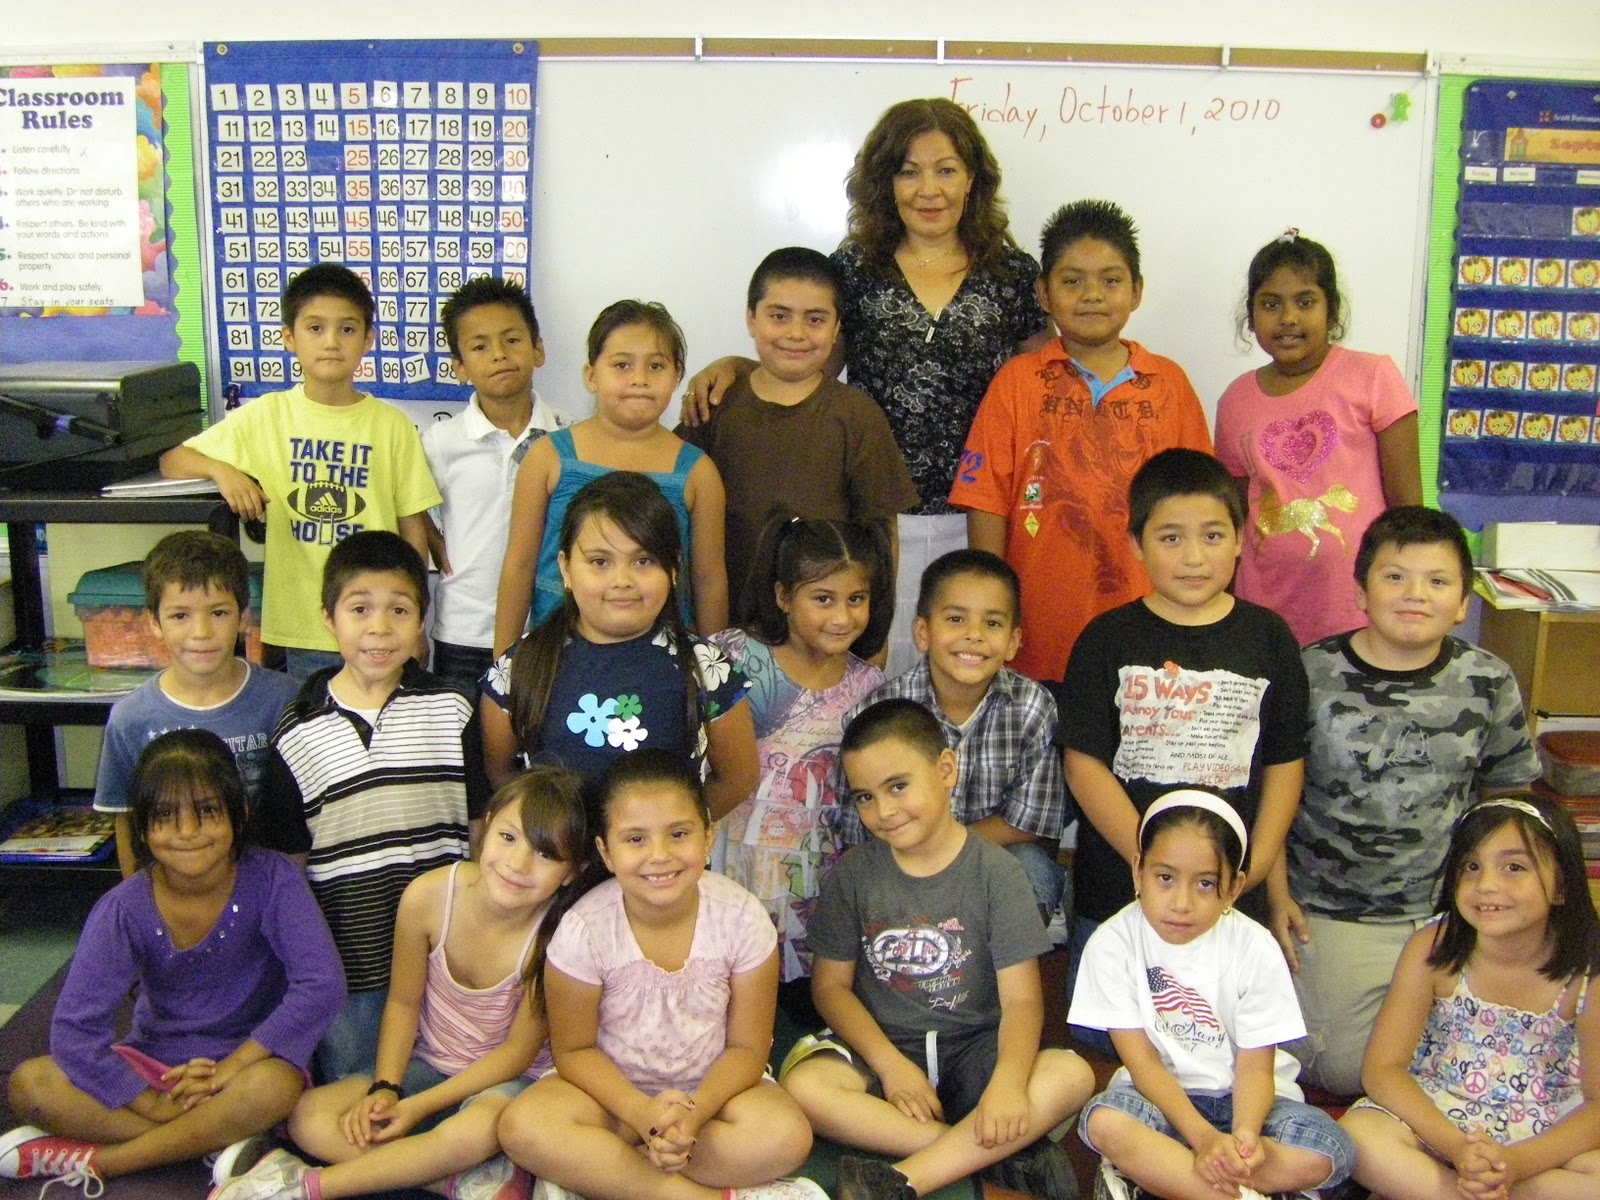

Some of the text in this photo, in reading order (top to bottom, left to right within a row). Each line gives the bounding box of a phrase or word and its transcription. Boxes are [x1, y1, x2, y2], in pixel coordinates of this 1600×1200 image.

[0, 88, 124, 107] Classroom
[220, 87, 527, 106] 1 2 3 4 5 6 7 8 9 10
[1060, 84, 1167, 125] October
[1203, 97, 1281, 123] 2010
[22, 110, 93, 129] Rules
[225, 119, 526, 137] 11 12 13 14 15 16 17 18 19 20
[13, 145, 35, 153] Listen
[221, 150, 526, 167] 21 22 23 25 26 27 28 29 30
[41, 167, 80, 175] directions
[16, 188, 35, 196] Work
[80, 188, 93, 196] not
[95, 188, 123, 196] disturb
[221, 182, 240, 198] 31
[256, 182, 278, 198] 32
[286, 181, 308, 197] 33
[313, 181, 336, 197] 34
[347, 181, 369, 197] 35
[380, 180, 399, 196] 36
[405, 180, 427, 196] 37
[439, 180, 461, 196] 38
[471, 180, 493, 196] 39
[16, 199, 40, 207] others
[43, 199, 59, 207] who
[17, 220, 47, 229] Respect
[78, 220, 89, 228] Be
[91, 220, 107, 228] kind
[109, 220, 126, 228] with
[226, 210, 522, 229] 41 42 43 44 45 46 47 48 49 50
[36, 230, 61, 238] words
[63, 230, 79, 238] and
[18, 251, 131, 261] Respect school and personal
[229, 241, 526, 258] 51 52 53 54 55 56 57 58 59 60
[20, 283, 40, 292] Work
[42, 283, 58, 291] and
[60, 283, 76, 293] play
[226, 273, 244, 288] 61
[257, 272, 278, 288] 62
[380, 272, 398, 288] 66
[406, 272, 426, 288] 67
[439, 272, 461, 288] 68
[504, 271, 525, 289] 70
[21, 296, 115, 307] Stay in your seats
[227, 301, 428, 318] 71 72 76 77
[1466, 321, 1482, 334] 12
[231, 330, 426, 347] 81 82 86 87
[235, 362, 253, 377] 91
[261, 362, 282, 378] 92
[353, 361, 374, 378] 95
[383, 362, 398, 379] 96
[405, 359, 424, 377] 97
[1462, 372, 1478, 385] 19
[1498, 374, 1518, 387] 20
[1537, 376, 1552, 389] 21
[1456, 422, 1584, 440] 26 27 28 29
[290, 438, 373, 465] TAKE IT
[290, 462, 369, 487] TO THE
[310, 505, 342, 514] adidas
[1124, 675, 1148, 700] 15
[1183, 762, 1205, 771] PLAY
